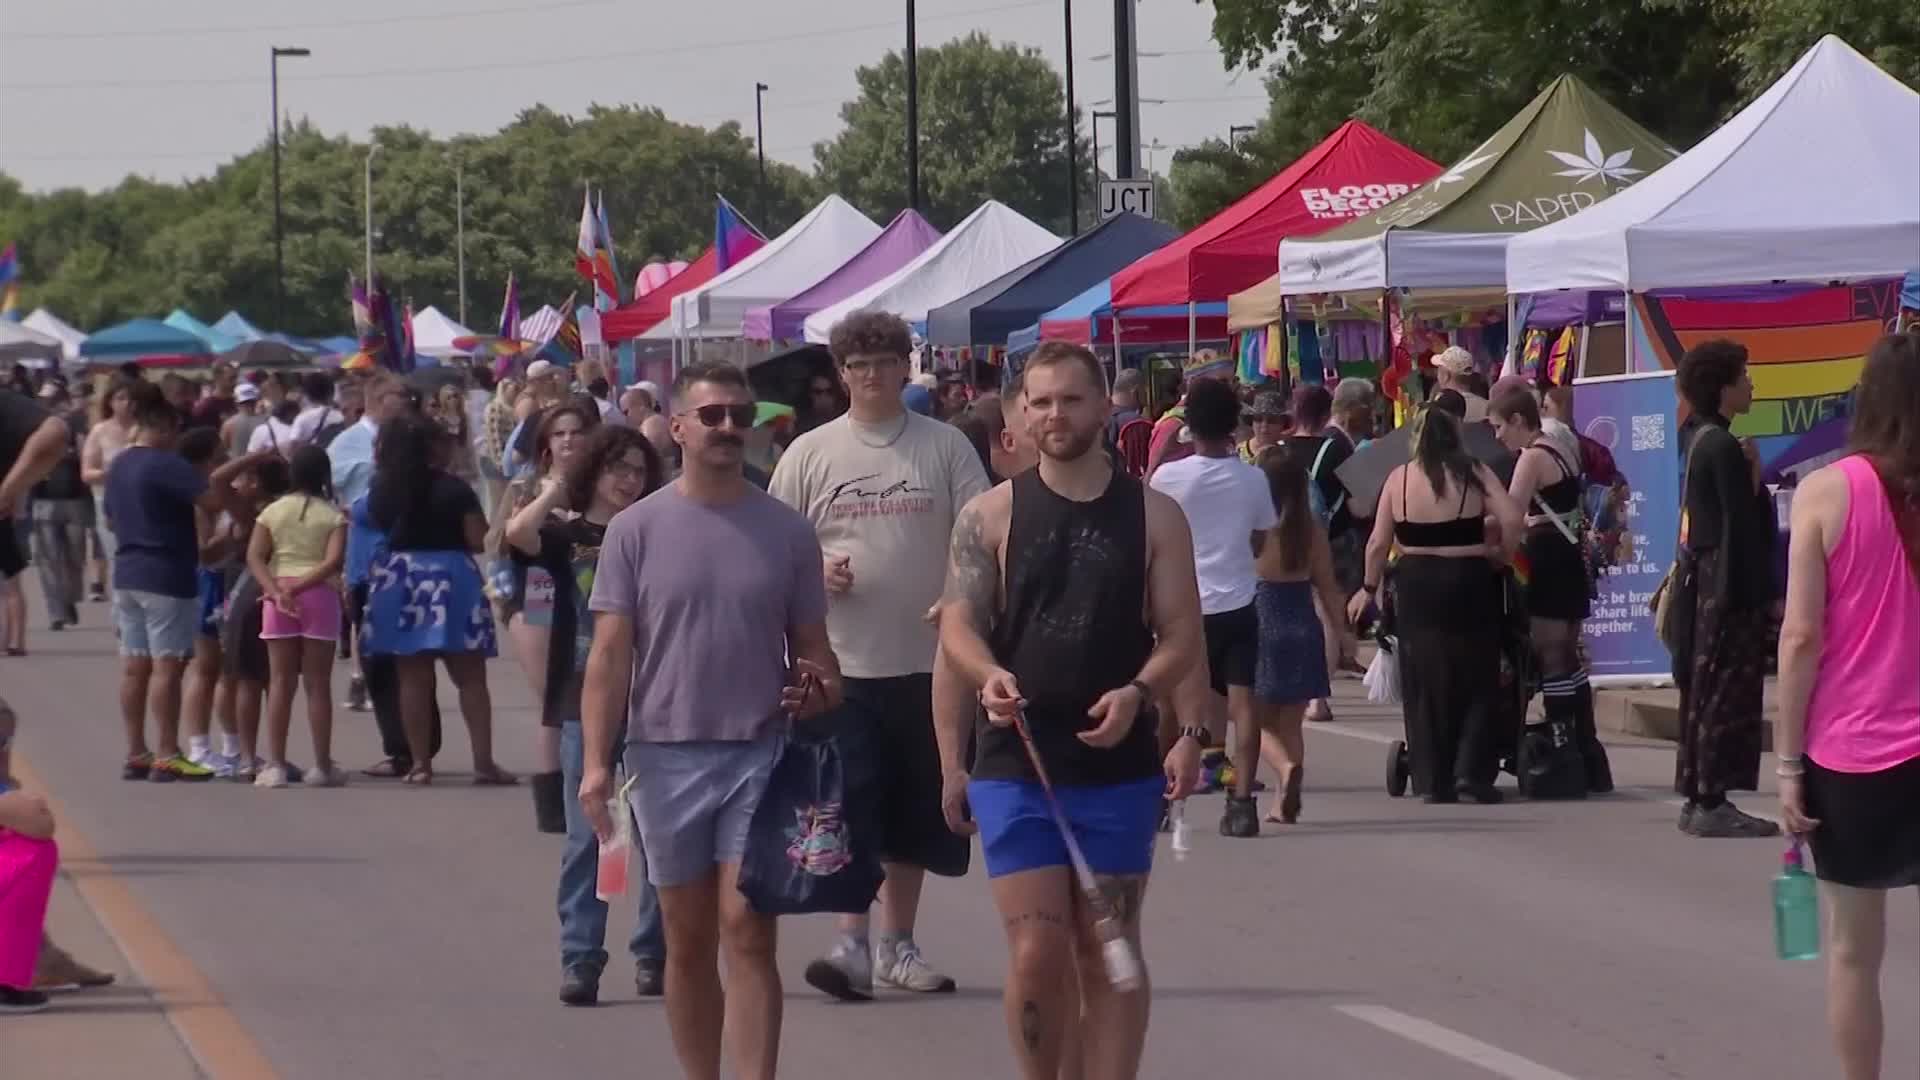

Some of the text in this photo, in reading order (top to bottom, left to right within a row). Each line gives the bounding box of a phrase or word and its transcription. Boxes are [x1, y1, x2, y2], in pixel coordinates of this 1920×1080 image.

[1103, 187, 1151, 213] JCT
[1300, 184, 1408, 201] FLOOR
[1610, 590, 1625, 604] be
[1594, 603, 1650, 619] share life
[1583, 619, 1638, 637] together.
